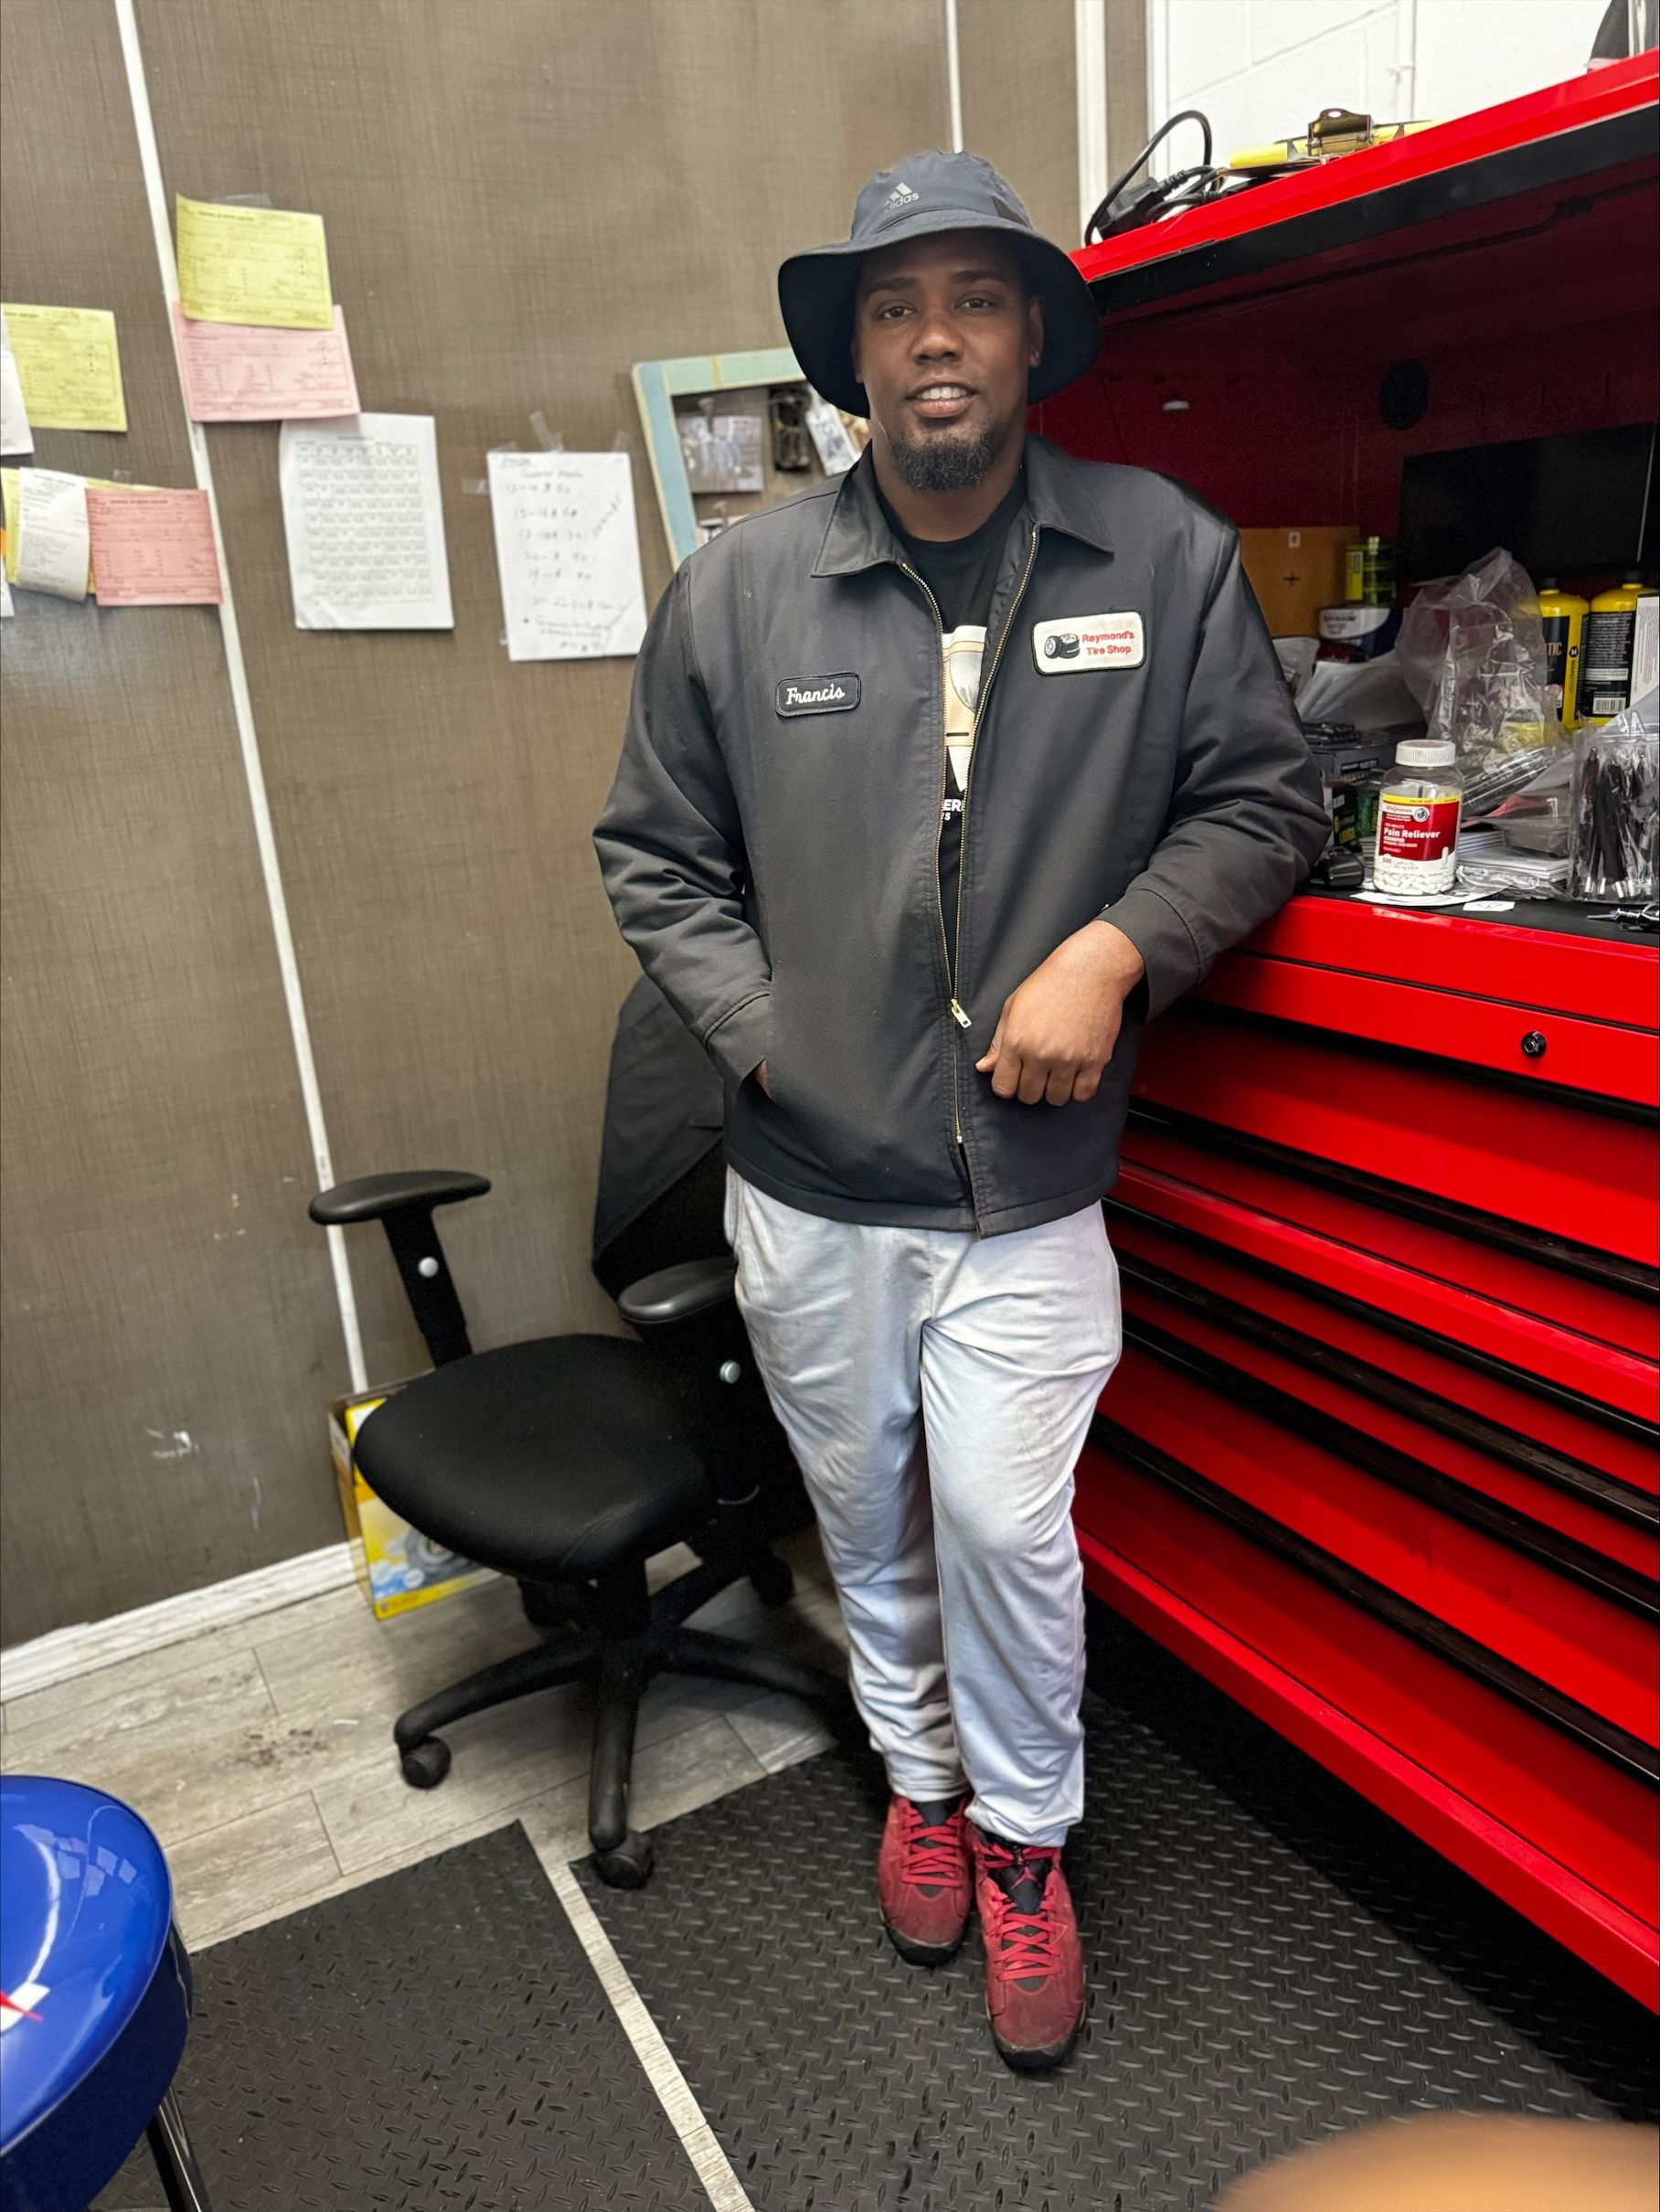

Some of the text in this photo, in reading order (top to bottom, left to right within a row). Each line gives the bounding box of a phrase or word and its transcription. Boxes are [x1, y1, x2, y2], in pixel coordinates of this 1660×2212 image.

[884, 192, 920, 215] didas
[1086, 644, 1132, 655] Tire Shop
[1547, 642, 1562, 656] TIC
[786, 683, 846, 705] Francis
[1383, 827, 1441, 839] Pain Reliever
